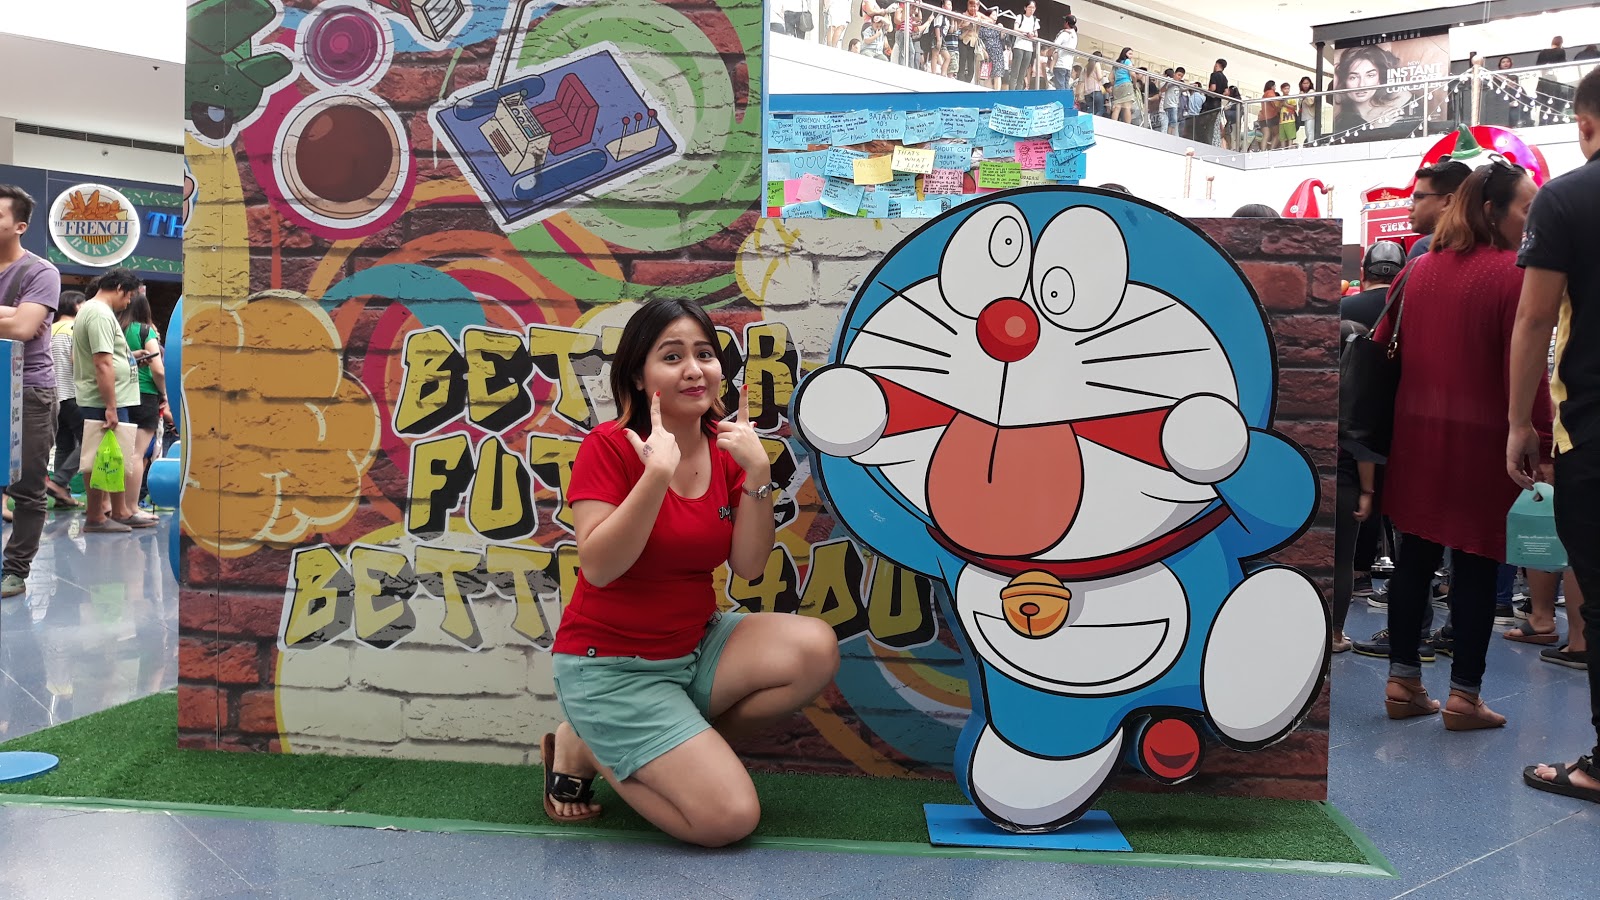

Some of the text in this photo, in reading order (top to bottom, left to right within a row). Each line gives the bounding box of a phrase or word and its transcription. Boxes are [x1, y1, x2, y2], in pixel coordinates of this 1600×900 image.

[1386, 62, 1443, 79] INSTANT
[64, 220, 129, 236] FRENCH
[70, 236, 124, 256] BAKER
[394, 324, 799, 434] BETR
[277, 542, 730, 650] BETT
